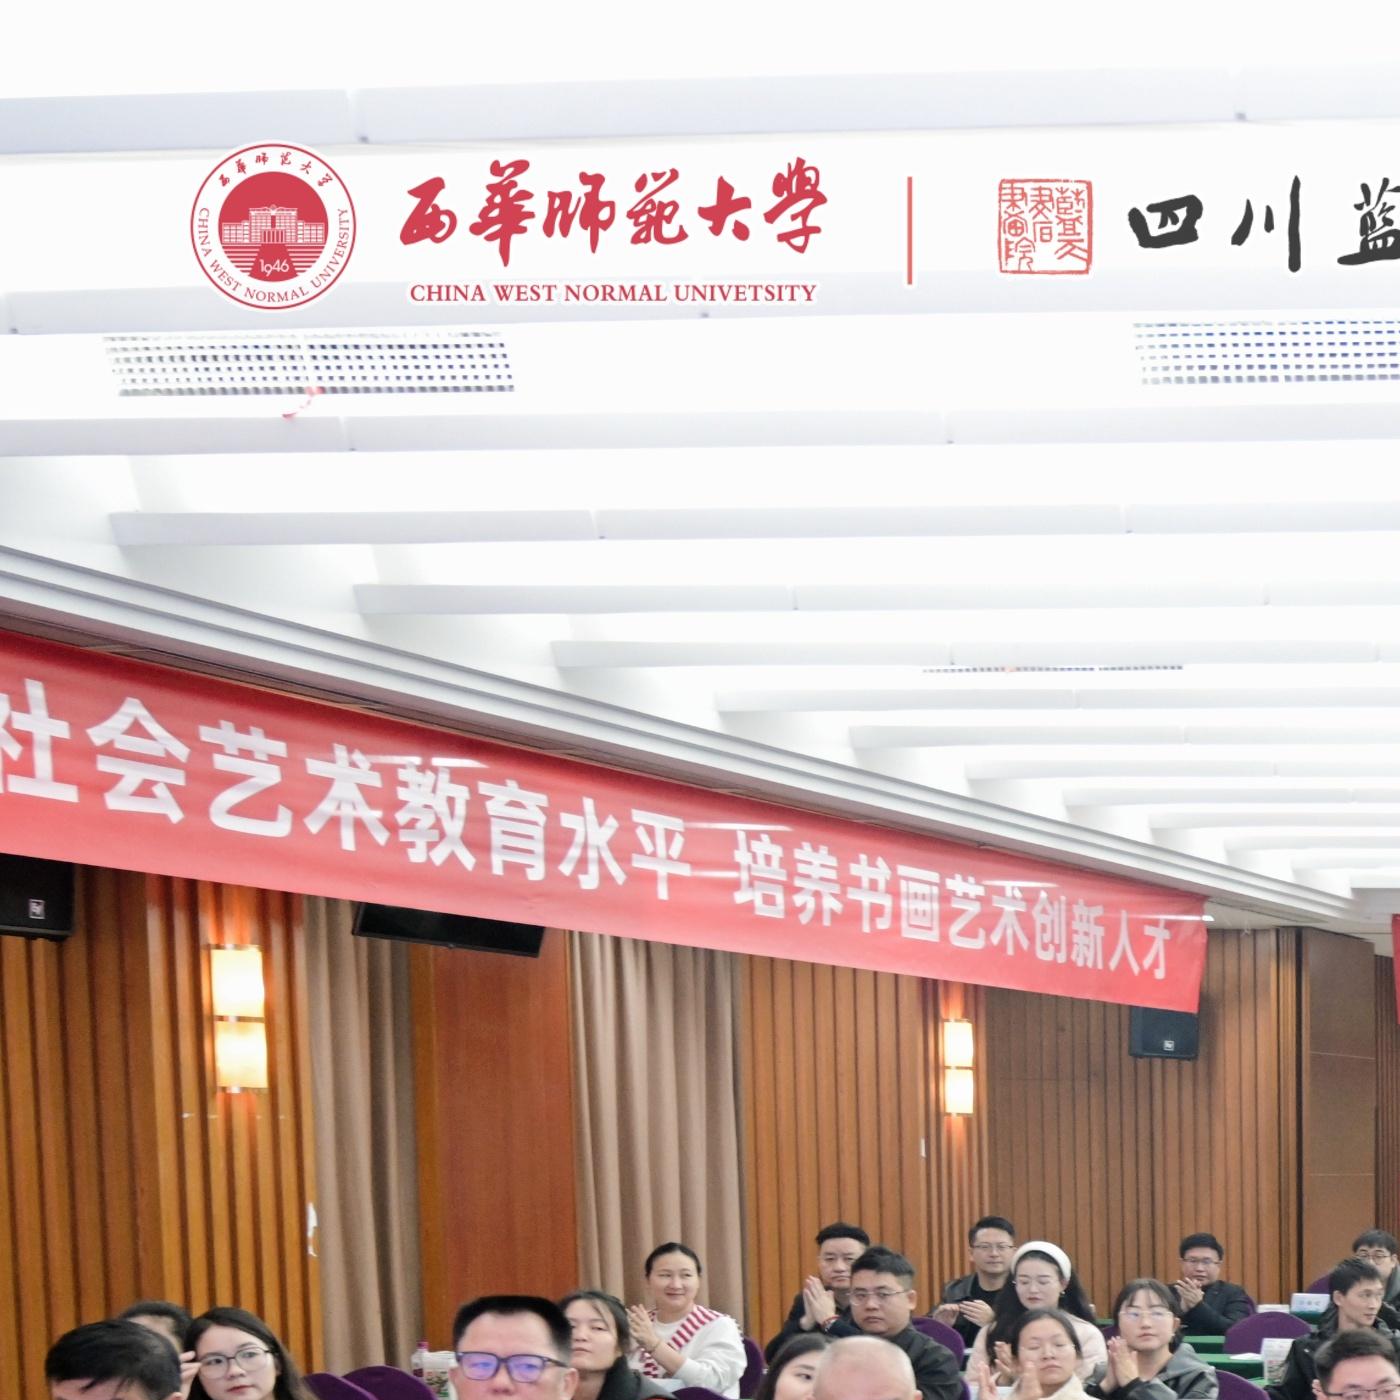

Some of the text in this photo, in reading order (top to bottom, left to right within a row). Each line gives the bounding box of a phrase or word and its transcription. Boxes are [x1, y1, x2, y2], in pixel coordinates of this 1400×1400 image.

[0, 678, 1171, 980] 社会艺术教育水平 培养书画艺术创新人才
